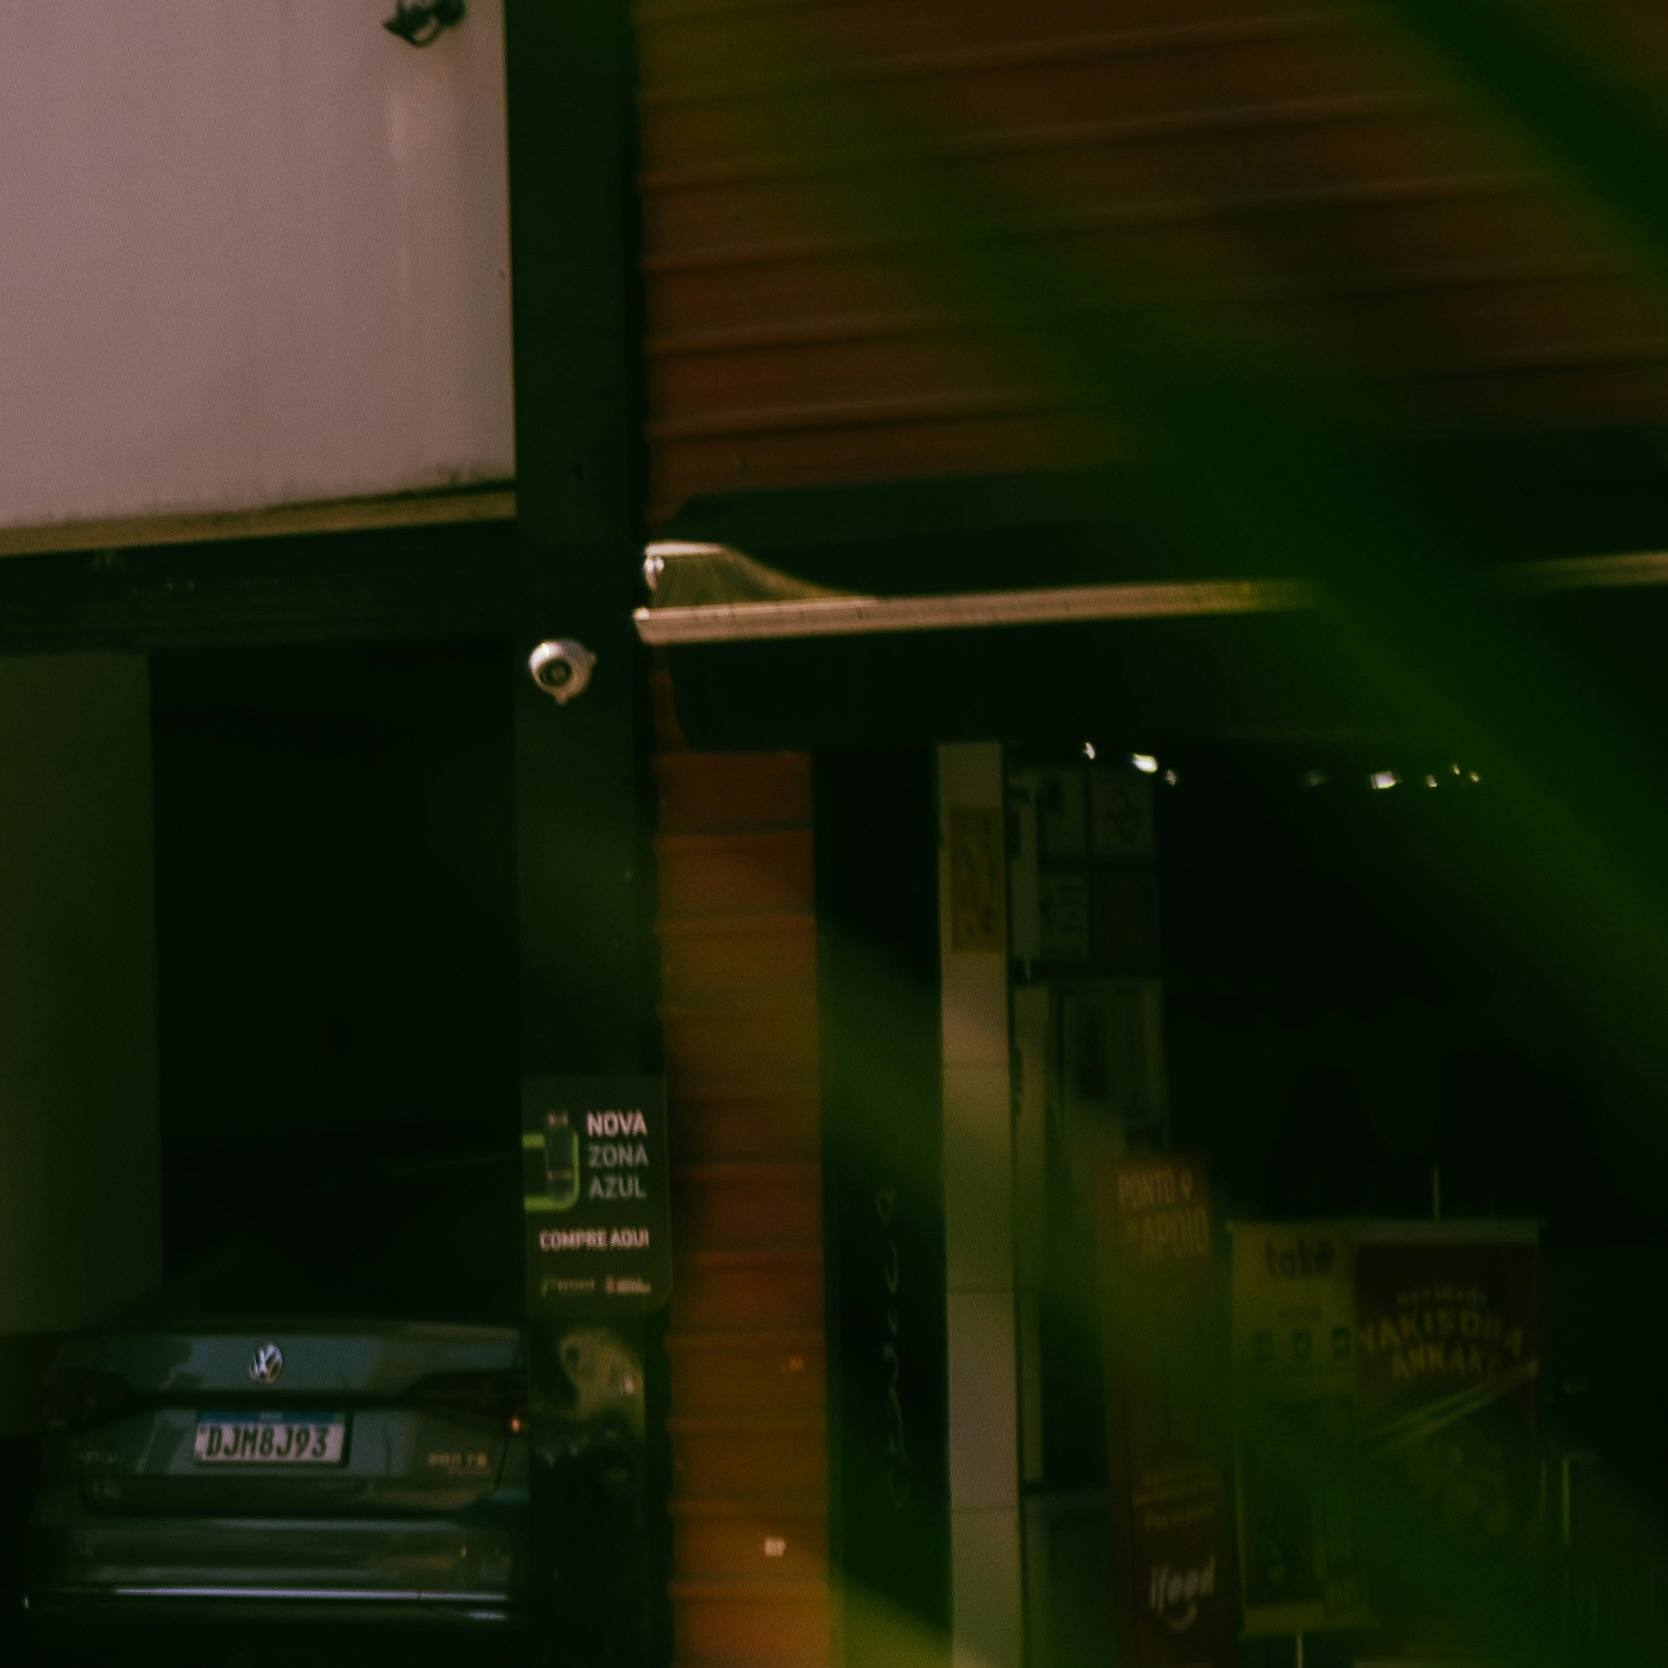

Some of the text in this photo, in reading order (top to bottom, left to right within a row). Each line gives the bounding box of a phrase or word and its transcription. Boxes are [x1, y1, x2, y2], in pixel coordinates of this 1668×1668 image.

[587, 1111, 647, 1137] NOVA
[588, 1143, 648, 1167] ZONA
[589, 1175, 646, 1199] AZUL
[539, 1226, 650, 1252] COMPRE AQUI
[206, 1425, 330, 1458] DJM8J93
